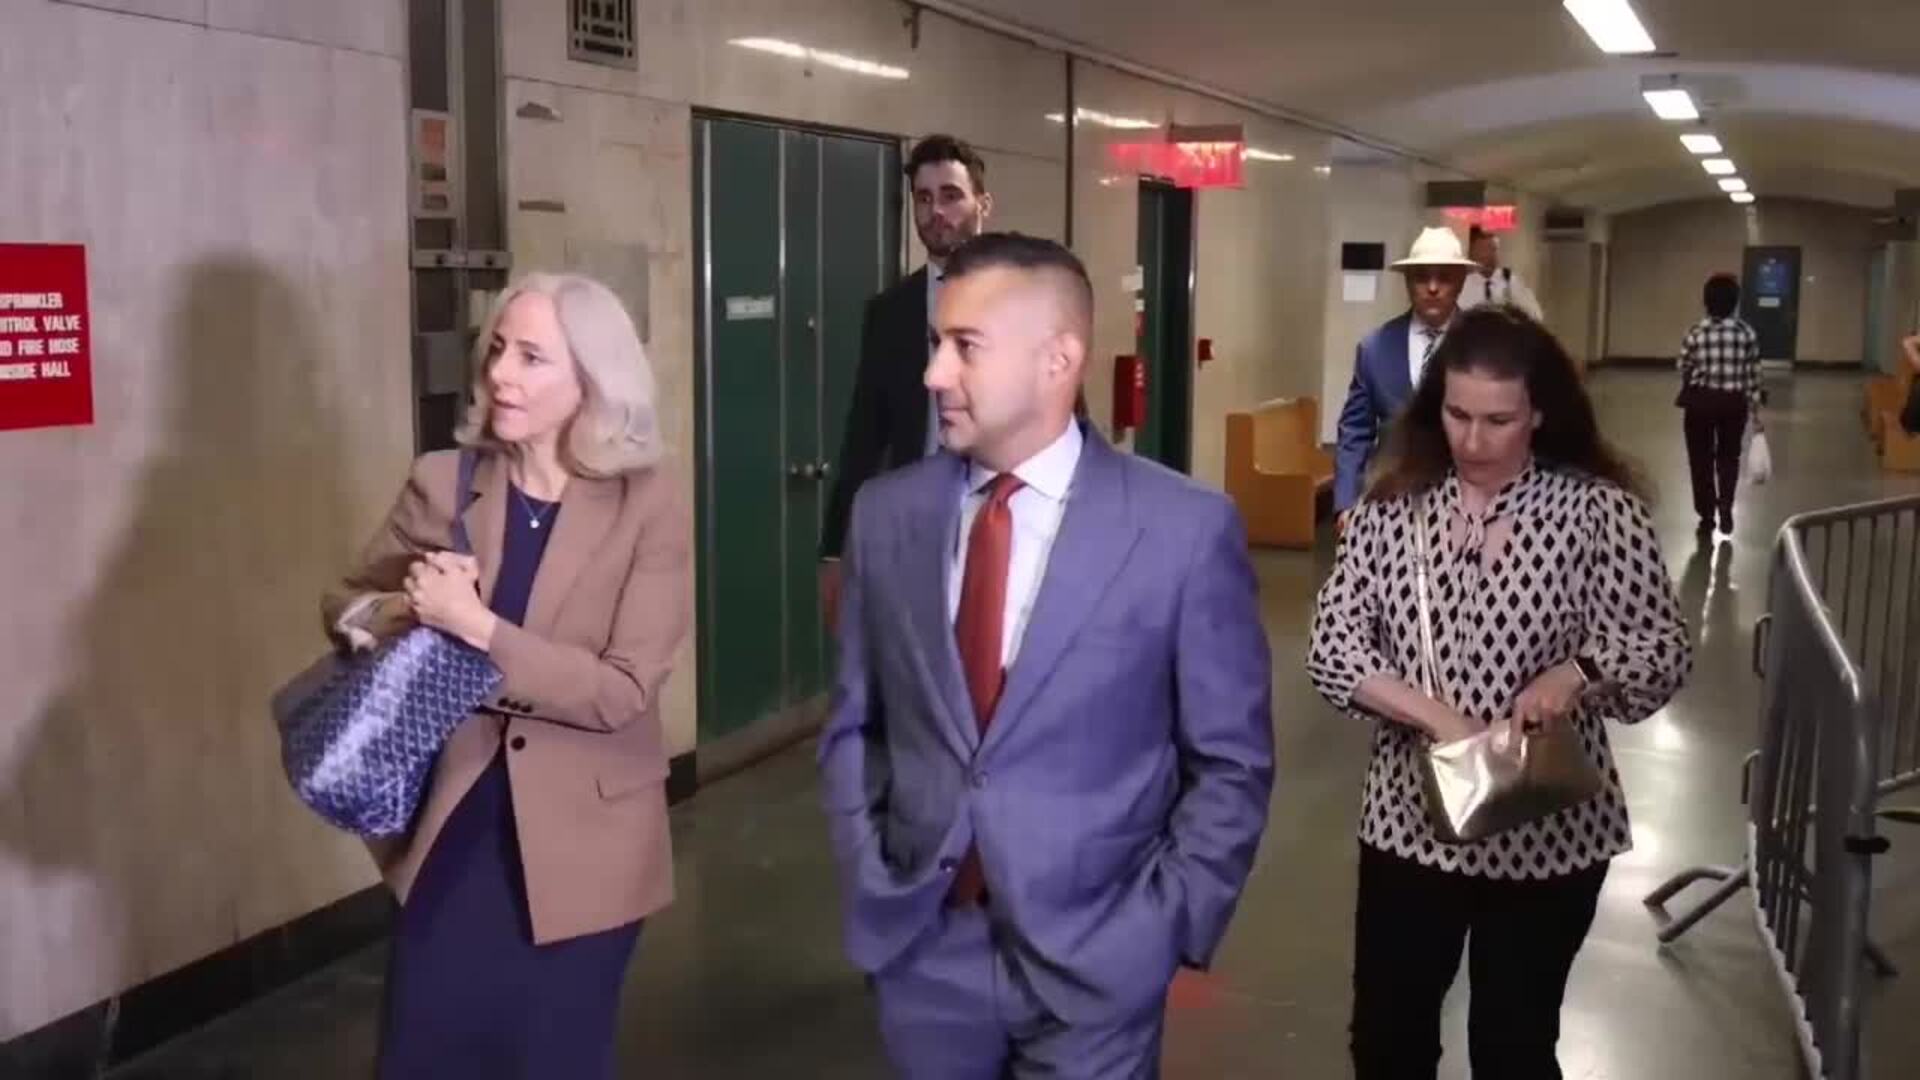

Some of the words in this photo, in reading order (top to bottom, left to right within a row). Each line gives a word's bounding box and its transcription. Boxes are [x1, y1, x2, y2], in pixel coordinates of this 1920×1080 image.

[42, 314, 82, 333] VALVE
[17, 338, 44, 356] FIRE
[48, 337, 80, 355] HOSE
[41, 360, 71, 378] HALL
